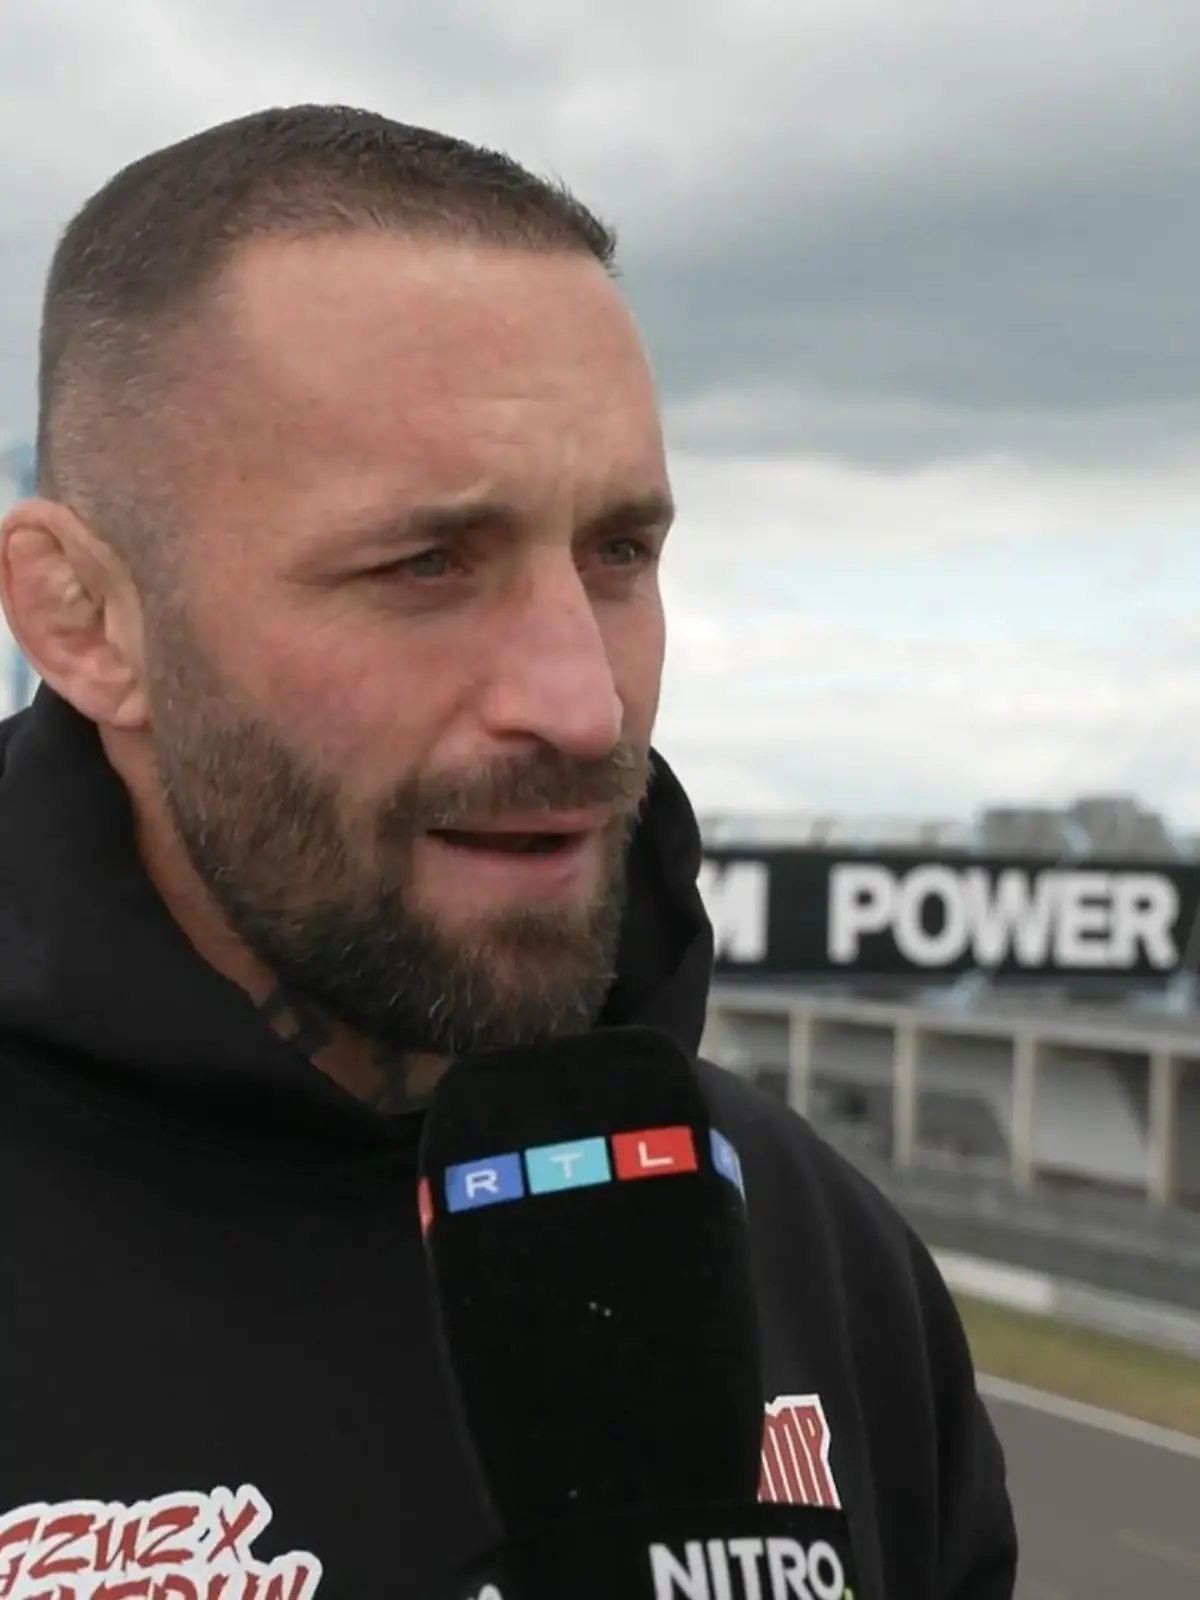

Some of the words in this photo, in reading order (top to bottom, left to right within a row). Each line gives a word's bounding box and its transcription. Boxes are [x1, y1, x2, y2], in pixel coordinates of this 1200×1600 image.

[827, 862, 1179, 968] POWER
[462, 1138, 676, 1200] RTL
[649, 1537, 845, 1600] NITRO
